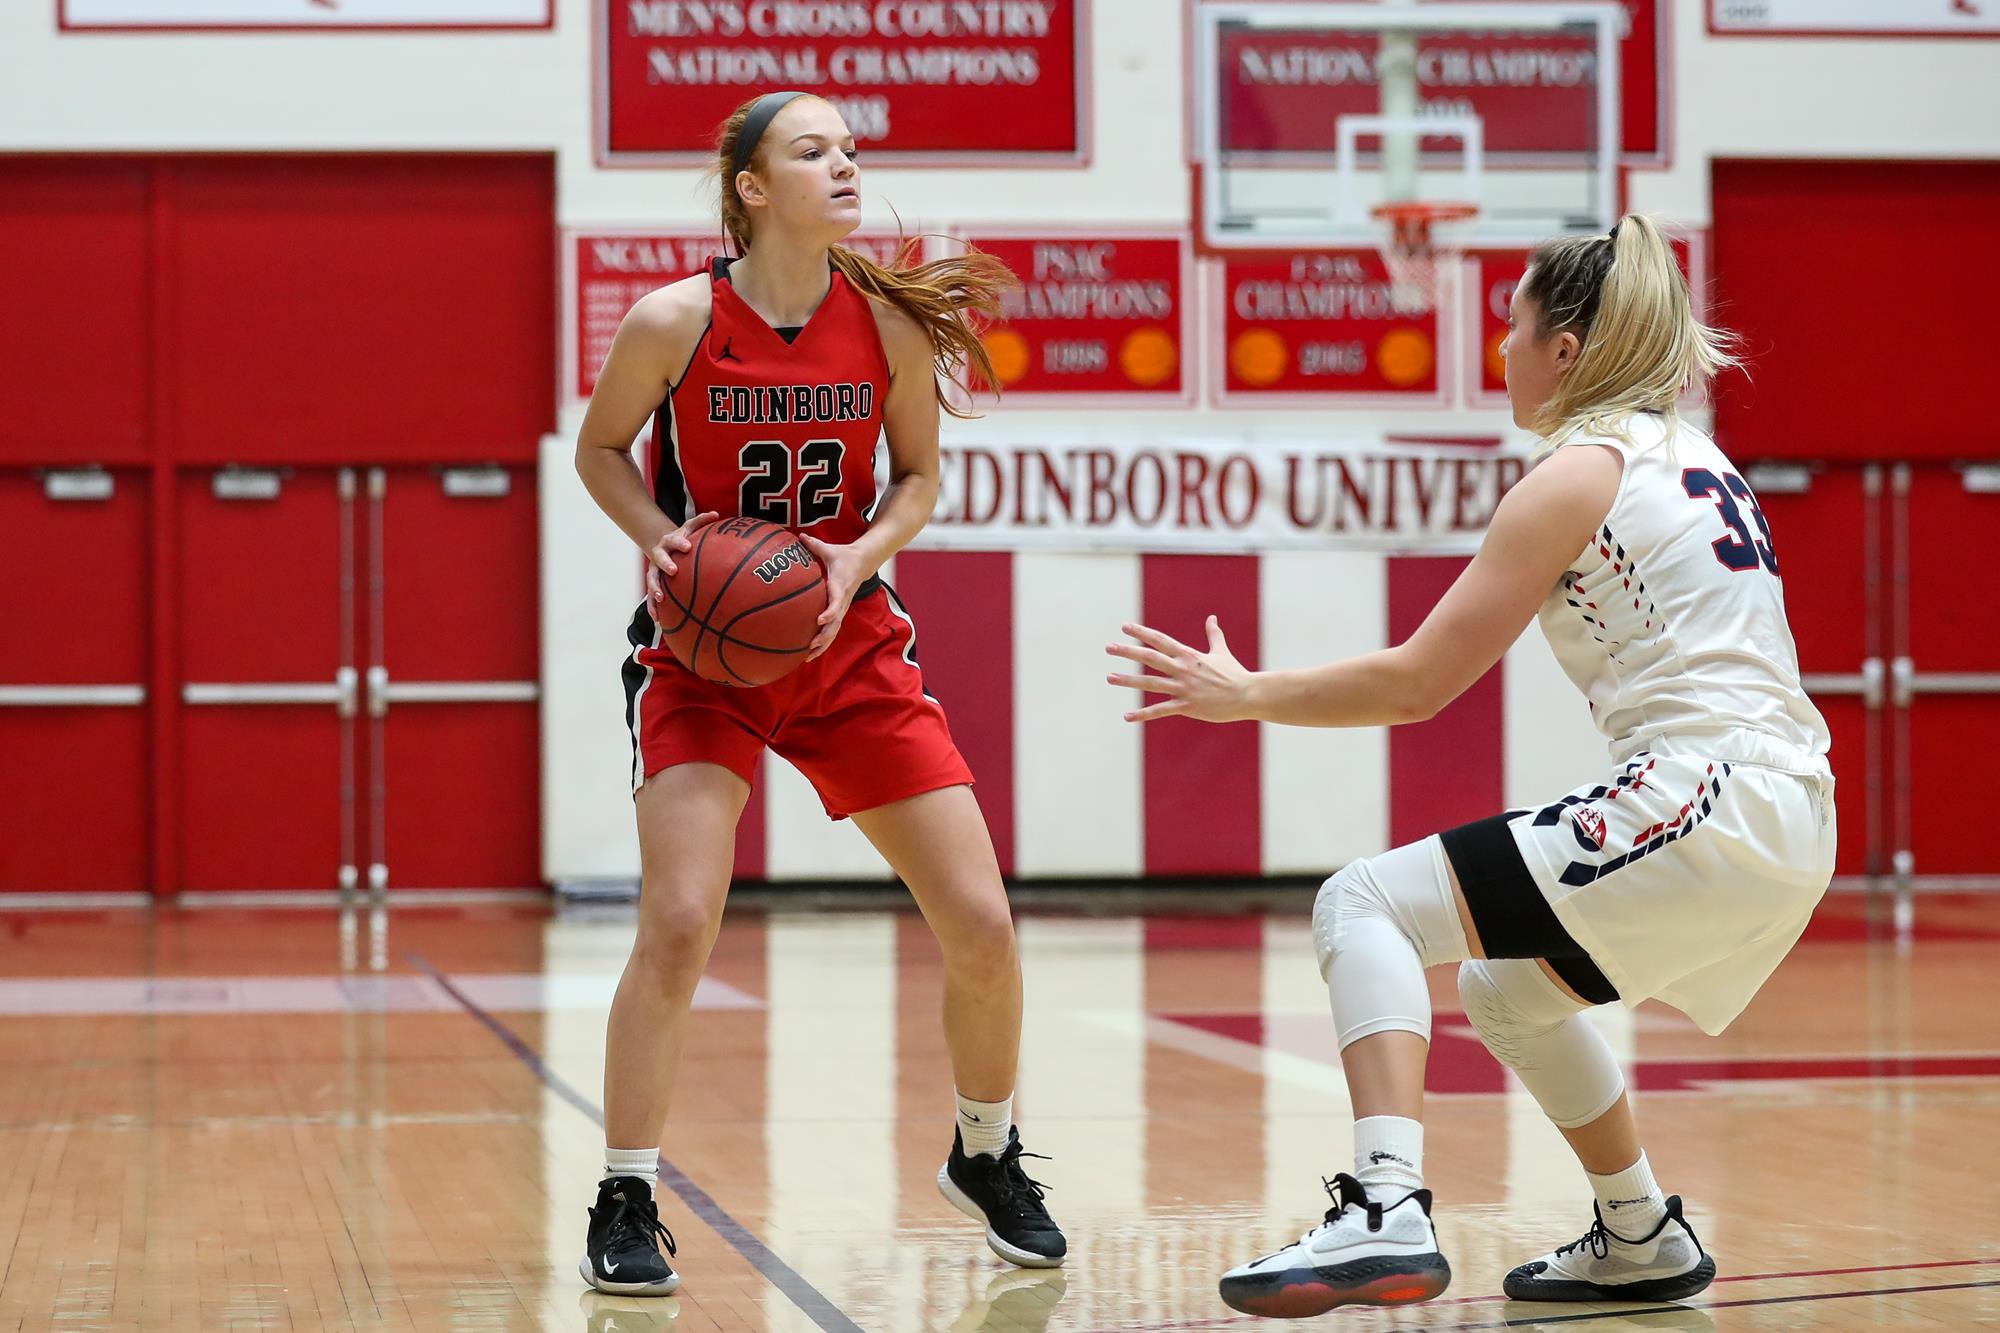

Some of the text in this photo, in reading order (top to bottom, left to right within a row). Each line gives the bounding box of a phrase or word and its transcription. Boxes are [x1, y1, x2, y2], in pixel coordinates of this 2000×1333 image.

[748, 0, 871, 37] CROSS
[874, 0, 1054, 37] COUNTRY
[647, 46, 1039, 85] NATIONAL CHAMPIONS
[1238, 46, 1598, 87] NATION CHAMPION
[591, 239, 677, 273] NCAA
[990, 279, 1172, 319] HAMPIONS
[1234, 279, 1395, 320] CHAMPIO
[707, 382, 873, 424] EDINBORO
[738, 438, 846, 528] 22
[1681, 467, 1780, 577] 33
